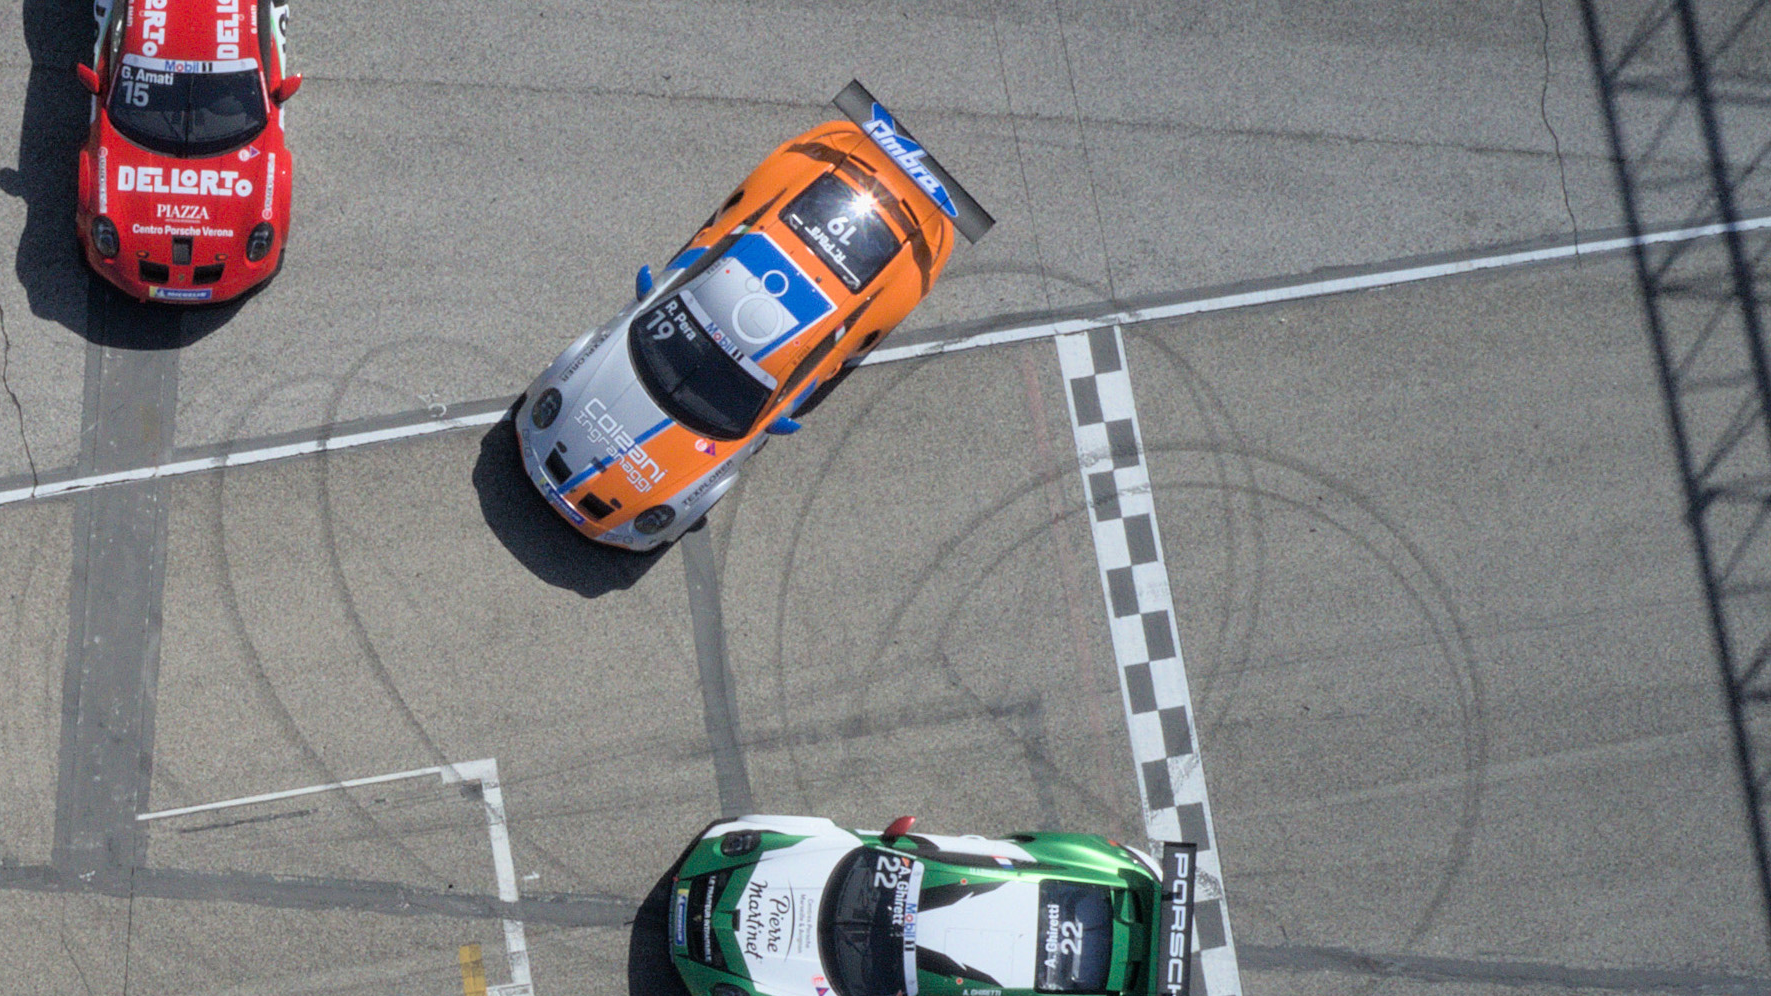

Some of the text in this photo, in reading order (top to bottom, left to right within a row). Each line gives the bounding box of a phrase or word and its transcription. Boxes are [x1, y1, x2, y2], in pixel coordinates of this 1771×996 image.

[121, 66, 173, 85] G. Amati
[164, 61, 198, 73] Mobil
[121, 80, 149, 107] 15
[864, 118, 943, 193] Ombra
[117, 165, 253, 197] DELLORTO
[156, 204, 209, 219] PIAZZA
[827, 211, 856, 244] 19
[132, 223, 233, 237] Centro Porsche Verona
[808, 226, 847, 264] R. Pera
[646, 309, 675, 340] 19
[663, 299, 696, 341] R. Pera
[702, 321, 735, 354] Mobil
[557, 333, 609, 382] TEXPLORER
[568, 410, 656, 492] Ingranaggi
[580, 396, 667, 483] Colzani
[681, 459, 732, 505] TEXPLORER
[708, 875, 715, 885] LE
[873, 855, 900, 889] 22
[897, 865, 910, 878] A.
[703, 886, 714, 917] TRAITEUR
[743, 880, 767, 959] Martinet
[766, 895, 790, 953] Pierre
[903, 902, 916, 938] Mobil
[1043, 903, 1060, 968] A. Ghiretti
[1059, 920, 1082, 955] 22
